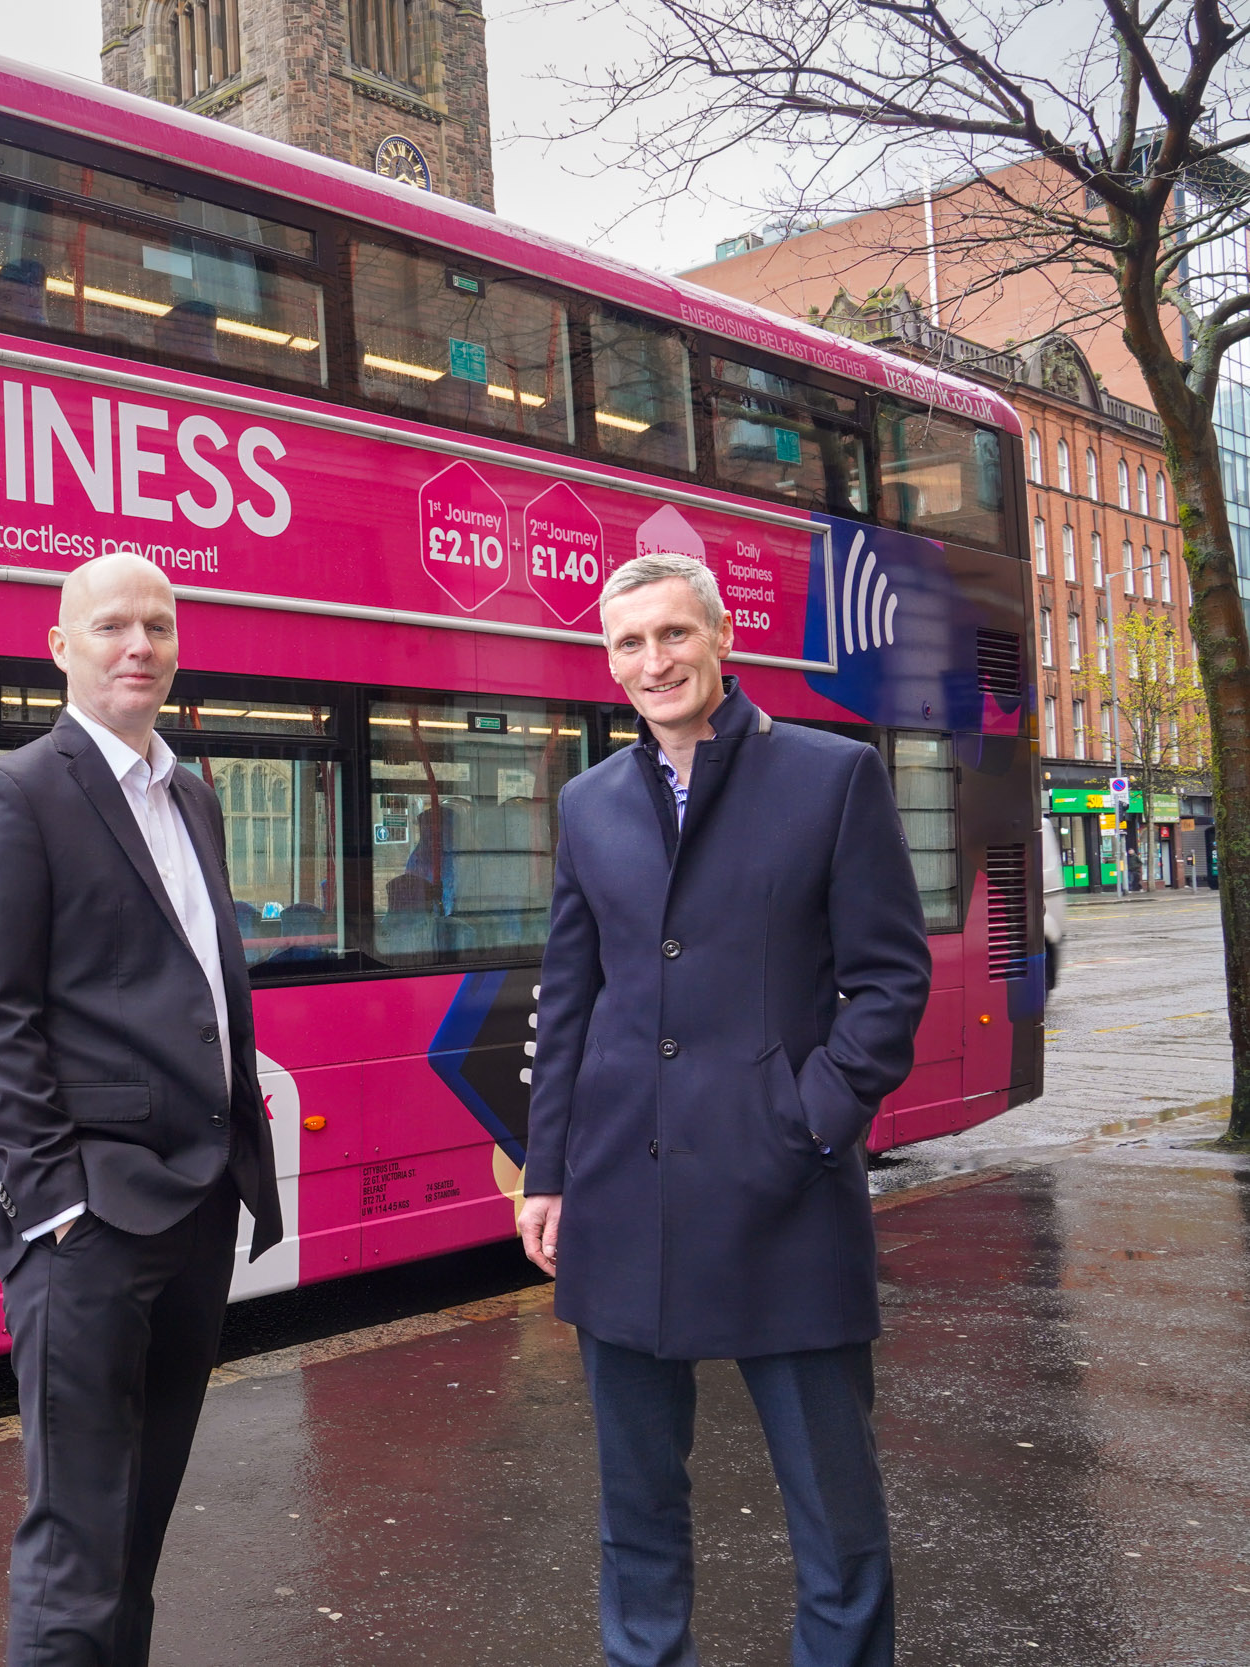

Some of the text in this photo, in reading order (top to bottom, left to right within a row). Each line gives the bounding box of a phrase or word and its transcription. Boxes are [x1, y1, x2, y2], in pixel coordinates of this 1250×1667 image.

[680, 303, 868, 380] ENERGISING BELFAST TOGETHER
[882, 363, 996, 423] translink.co.uk
[428, 499, 502, 534] 1st Journey
[530, 518, 598, 551] 2nd Journey
[429, 527, 503, 570] £2.10
[737, 540, 761, 562] Daily
[532, 544, 599, 585] £1.40
[726, 559, 773, 582] Tappiness
[726, 584, 775, 603] capped at
[735, 608, 770, 631] £3.50
[363, 1162, 400, 1176] CITYBUS LTD.
[363, 1177, 371, 1186] 22
[381, 1171, 408, 1183] VICTORIA
[363, 1183, 387, 1195] BELFAST
[426, 1179, 454, 1192] 74 SEATED
[433, 1188, 460, 1201] STANDING
[363, 1194, 387, 1206] BT2 7LX
[398, 1199, 410, 1209] KGS
